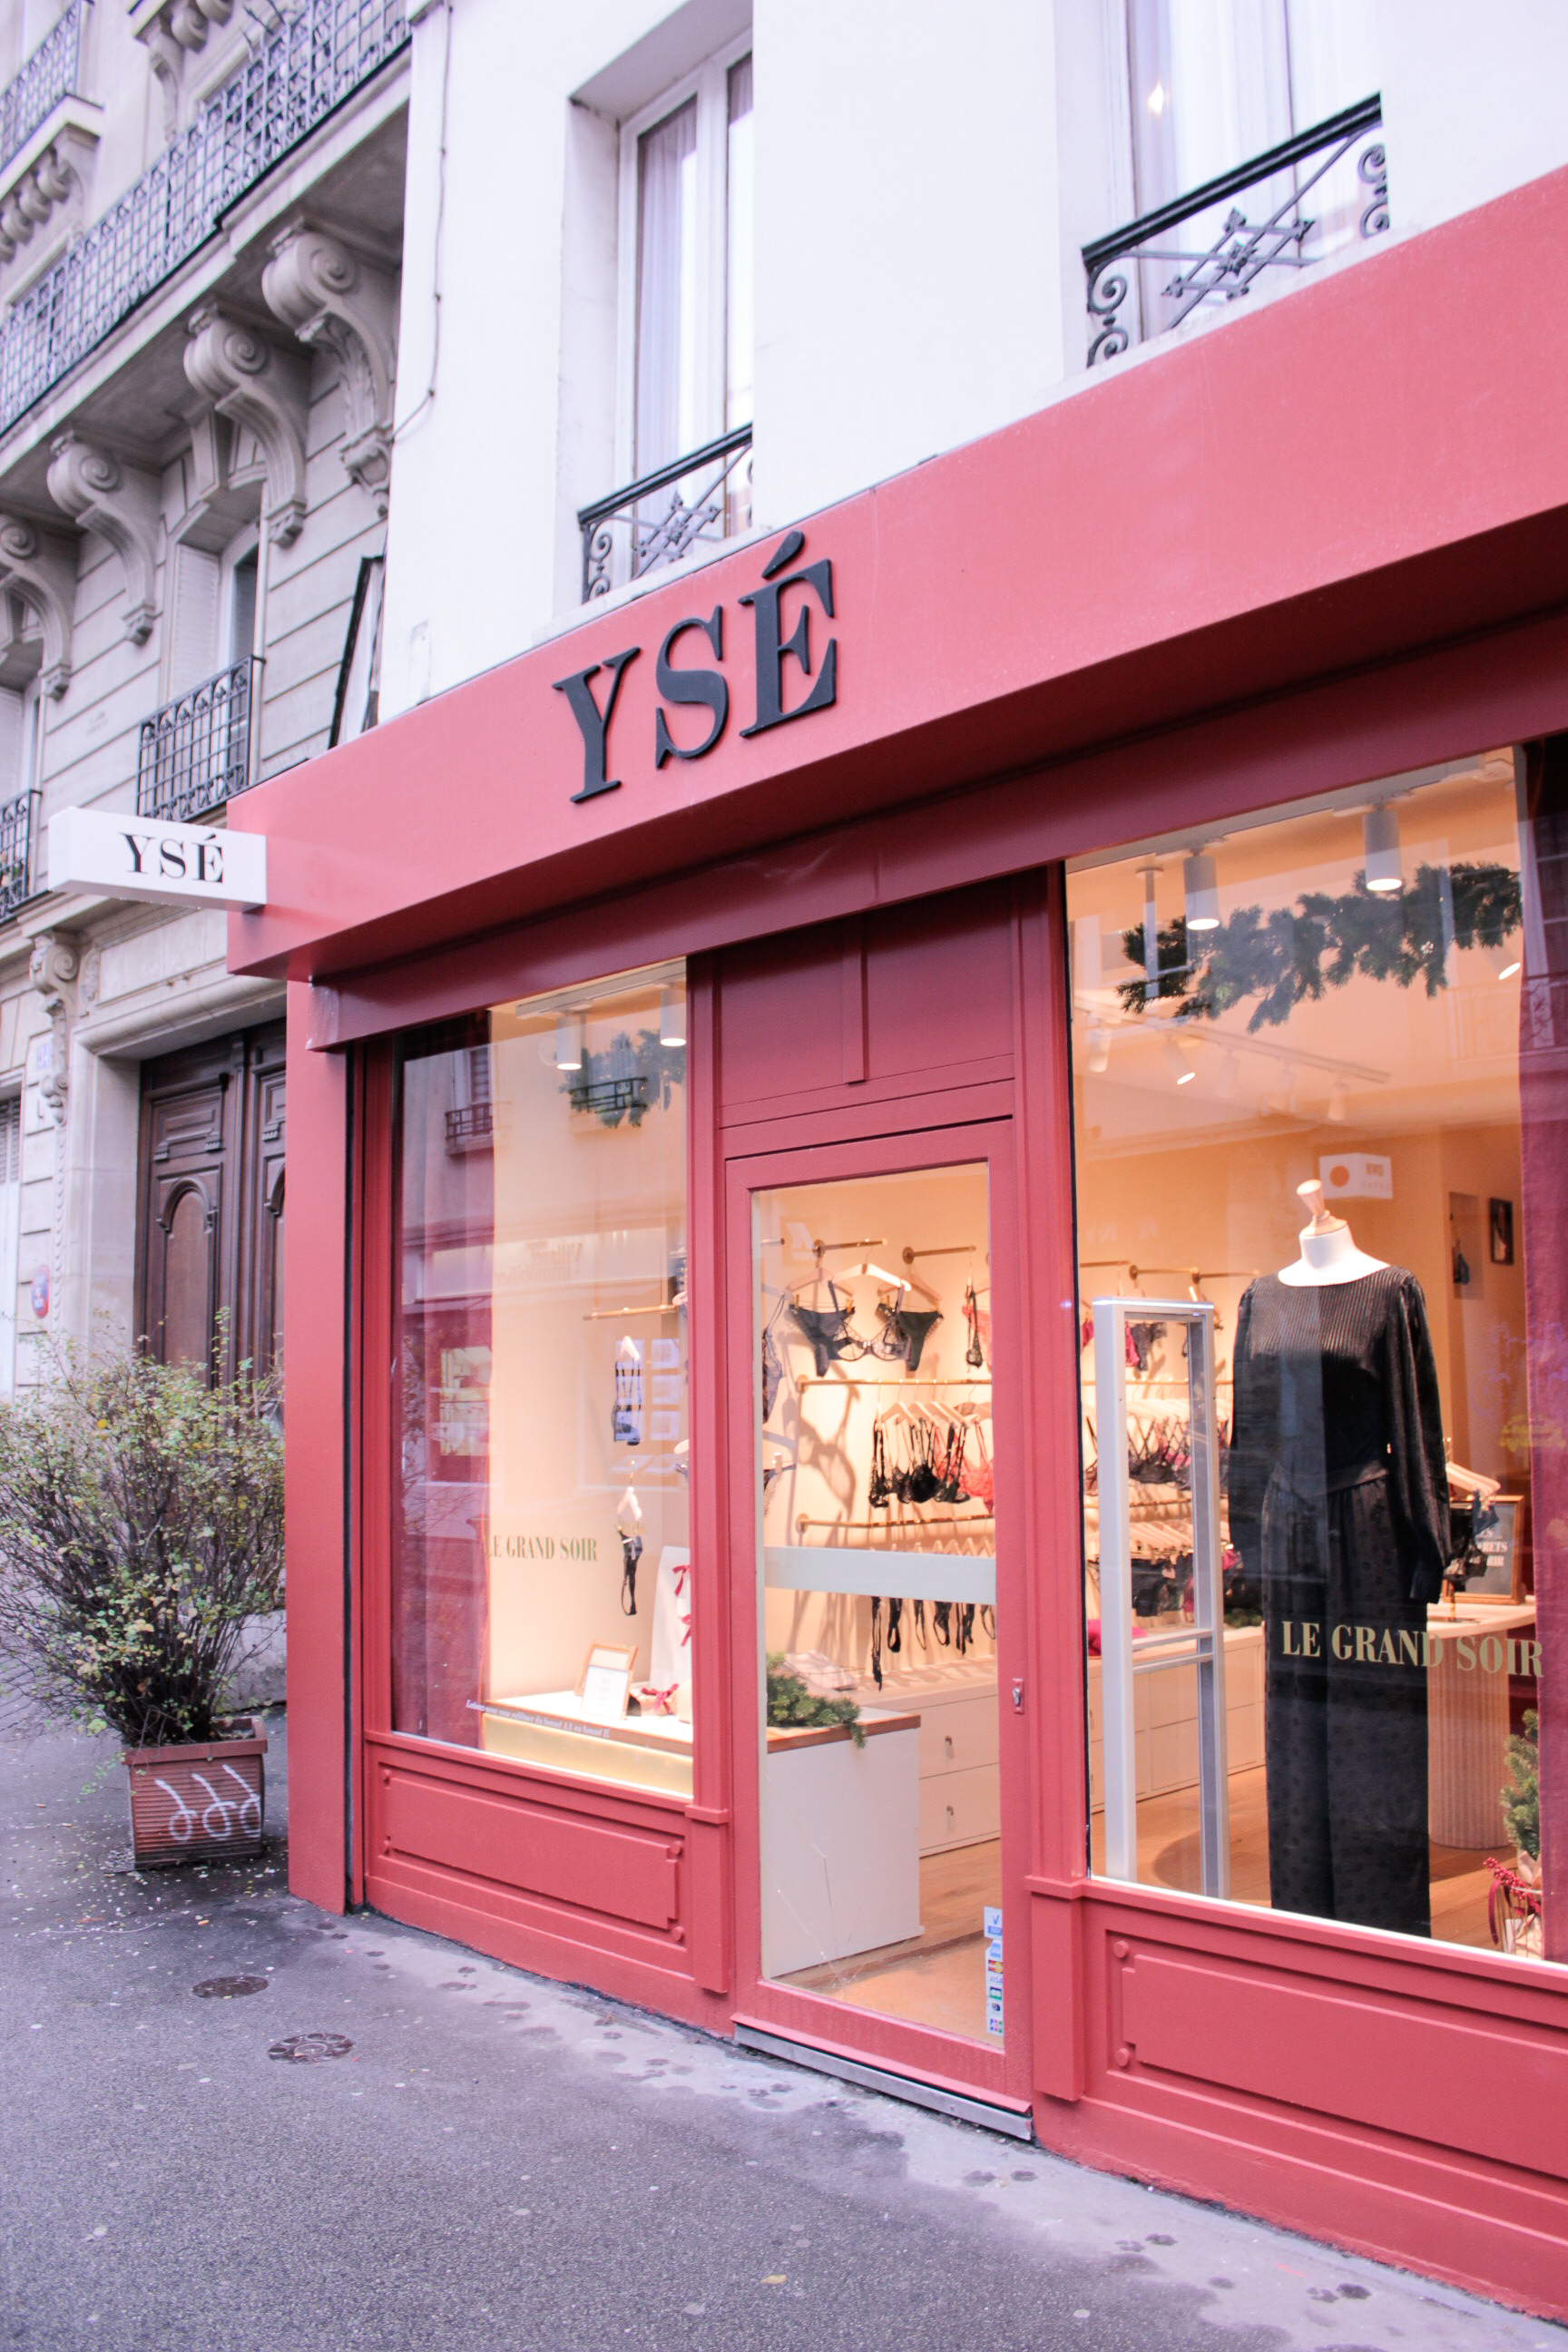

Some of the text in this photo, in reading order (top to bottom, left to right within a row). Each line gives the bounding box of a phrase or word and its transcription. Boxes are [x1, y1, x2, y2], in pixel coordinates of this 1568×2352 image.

[552, 530, 837, 804] YSÉ
[119, 833, 225, 884] YSÉ
[505, 1534, 555, 1561] GRAND
[559, 1536, 598, 1562] SOIR
[1282, 1621, 1544, 1678] LE GRAND SOIR
